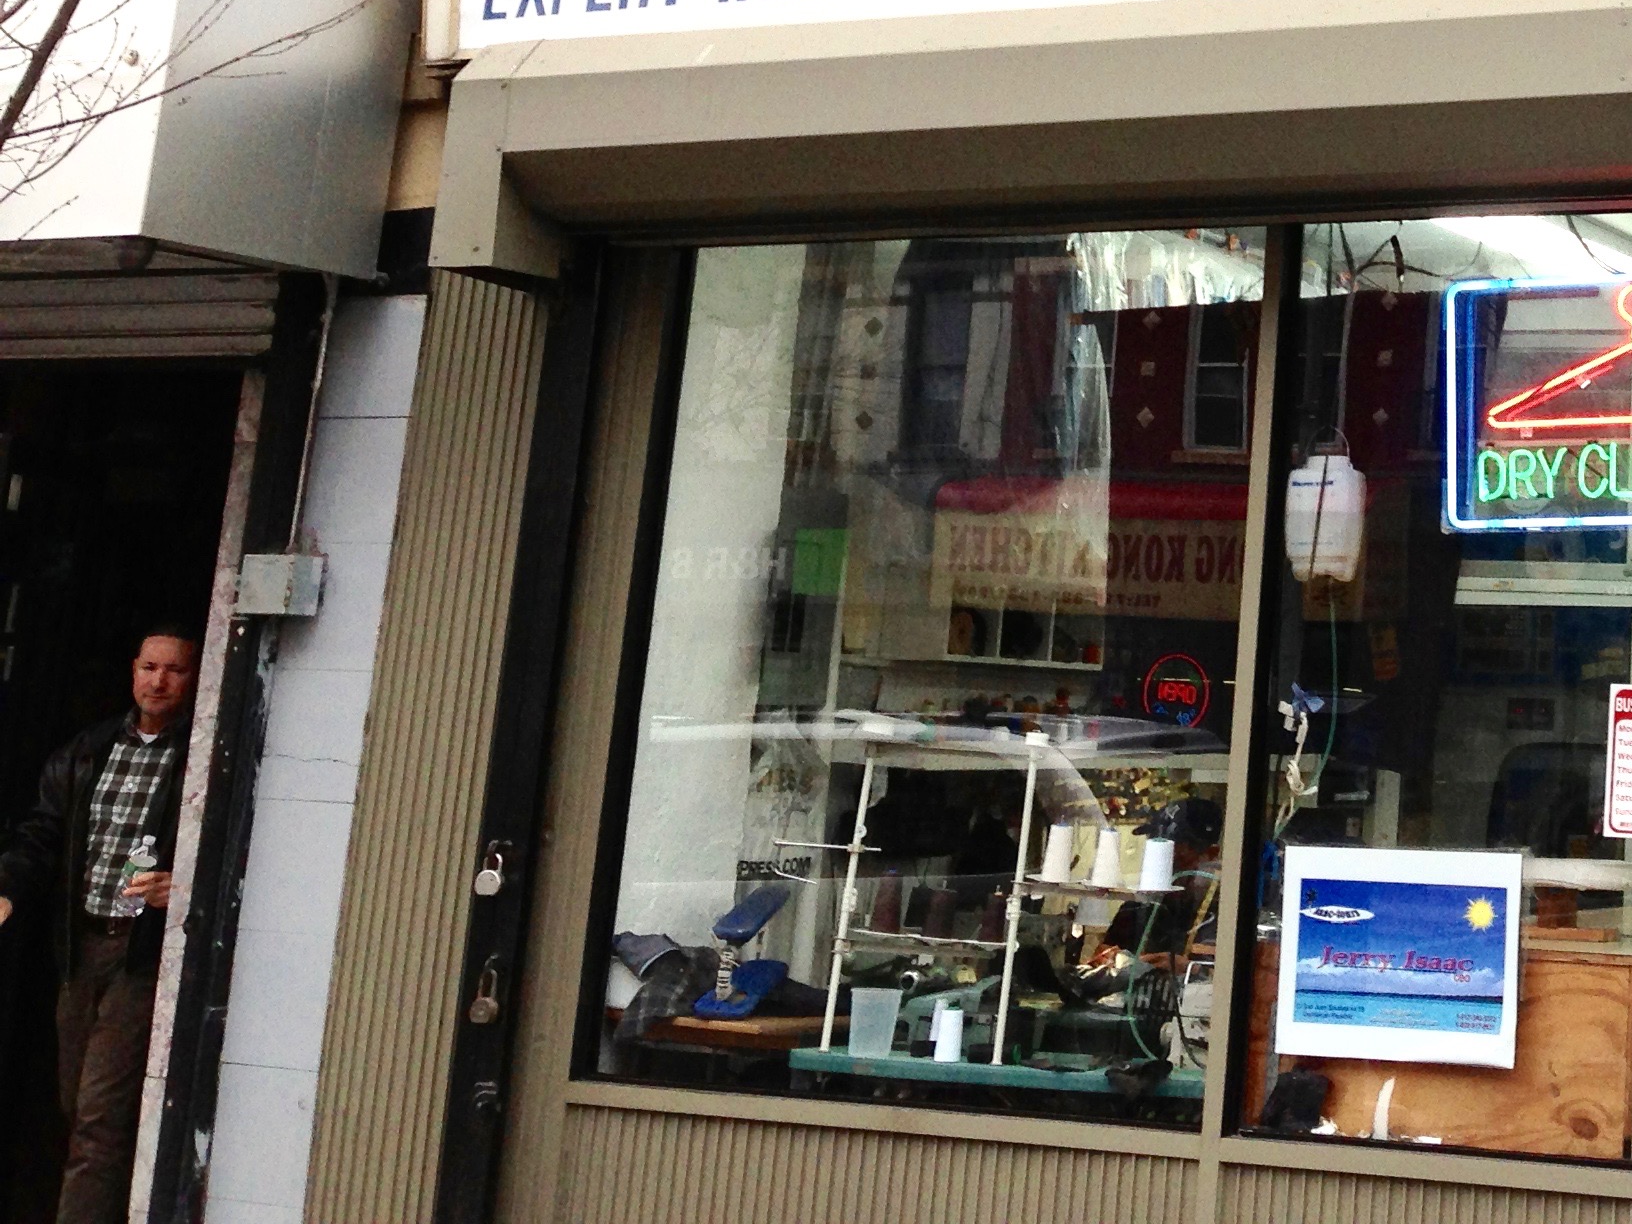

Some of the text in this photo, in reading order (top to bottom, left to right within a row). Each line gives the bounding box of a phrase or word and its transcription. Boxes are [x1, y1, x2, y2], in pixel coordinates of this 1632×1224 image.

[1477, 447, 1569, 503] DRY
[1317, 944, 1474, 973] Jerry Isaac
